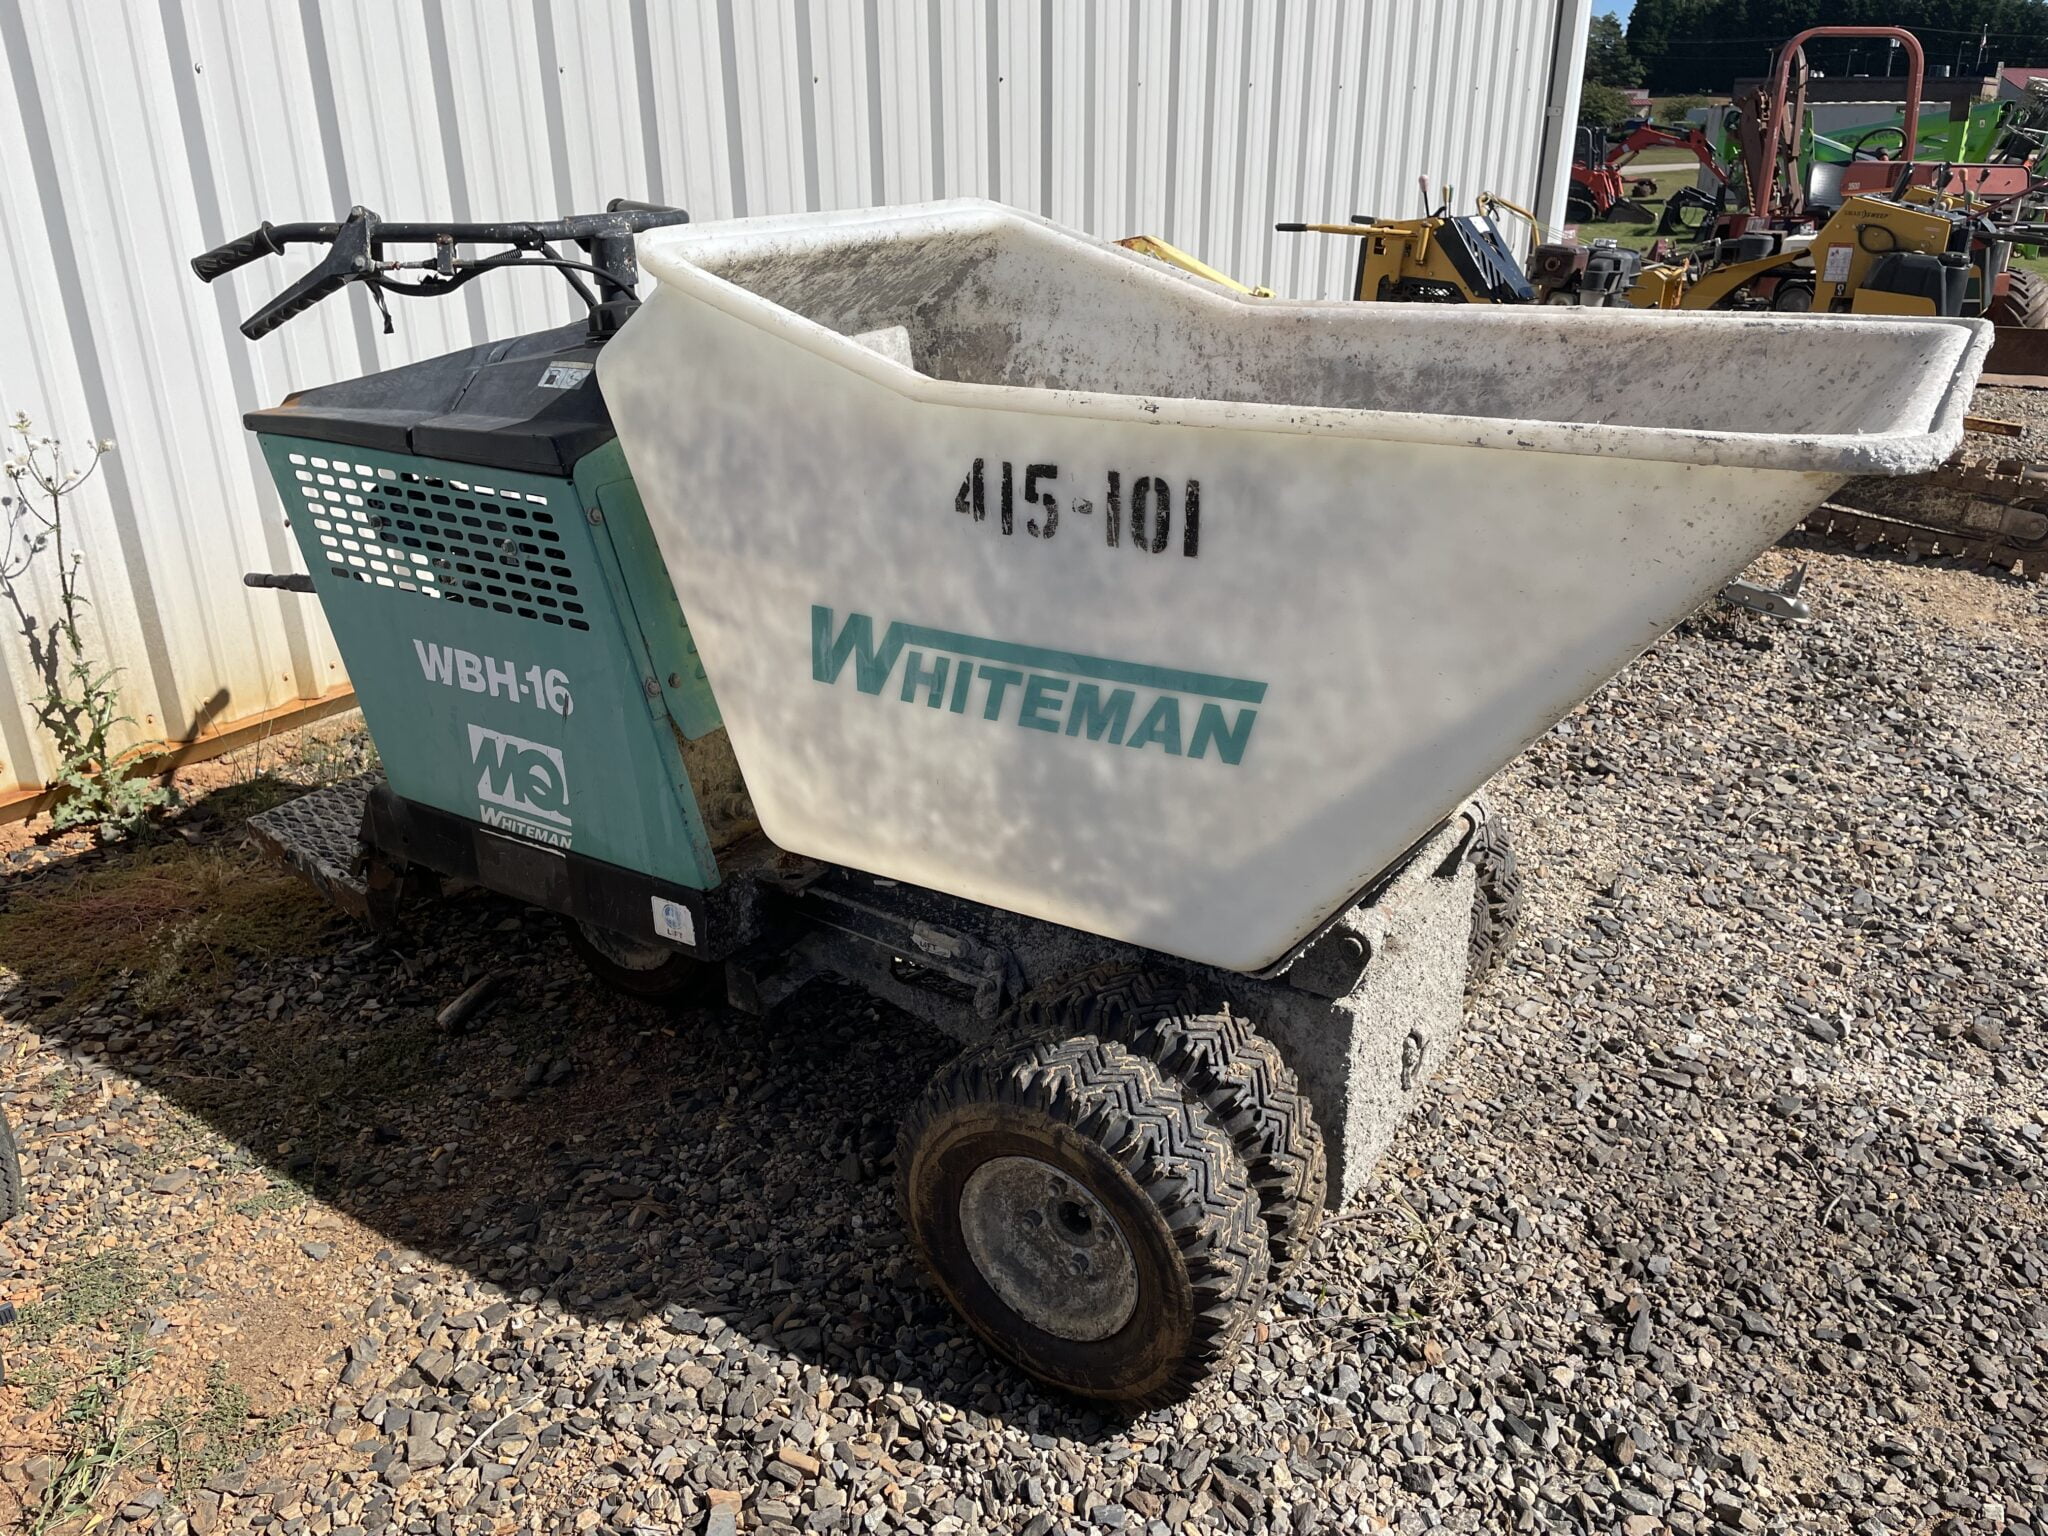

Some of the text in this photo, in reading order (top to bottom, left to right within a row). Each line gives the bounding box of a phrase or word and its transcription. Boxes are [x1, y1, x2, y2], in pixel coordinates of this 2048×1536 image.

[955, 458, 1200, 558] 415-101
[413, 639, 574, 716] WBH-16
[811, 605, 1268, 765] WHITEMAN
[480, 805, 572, 849] WHITEMAN
